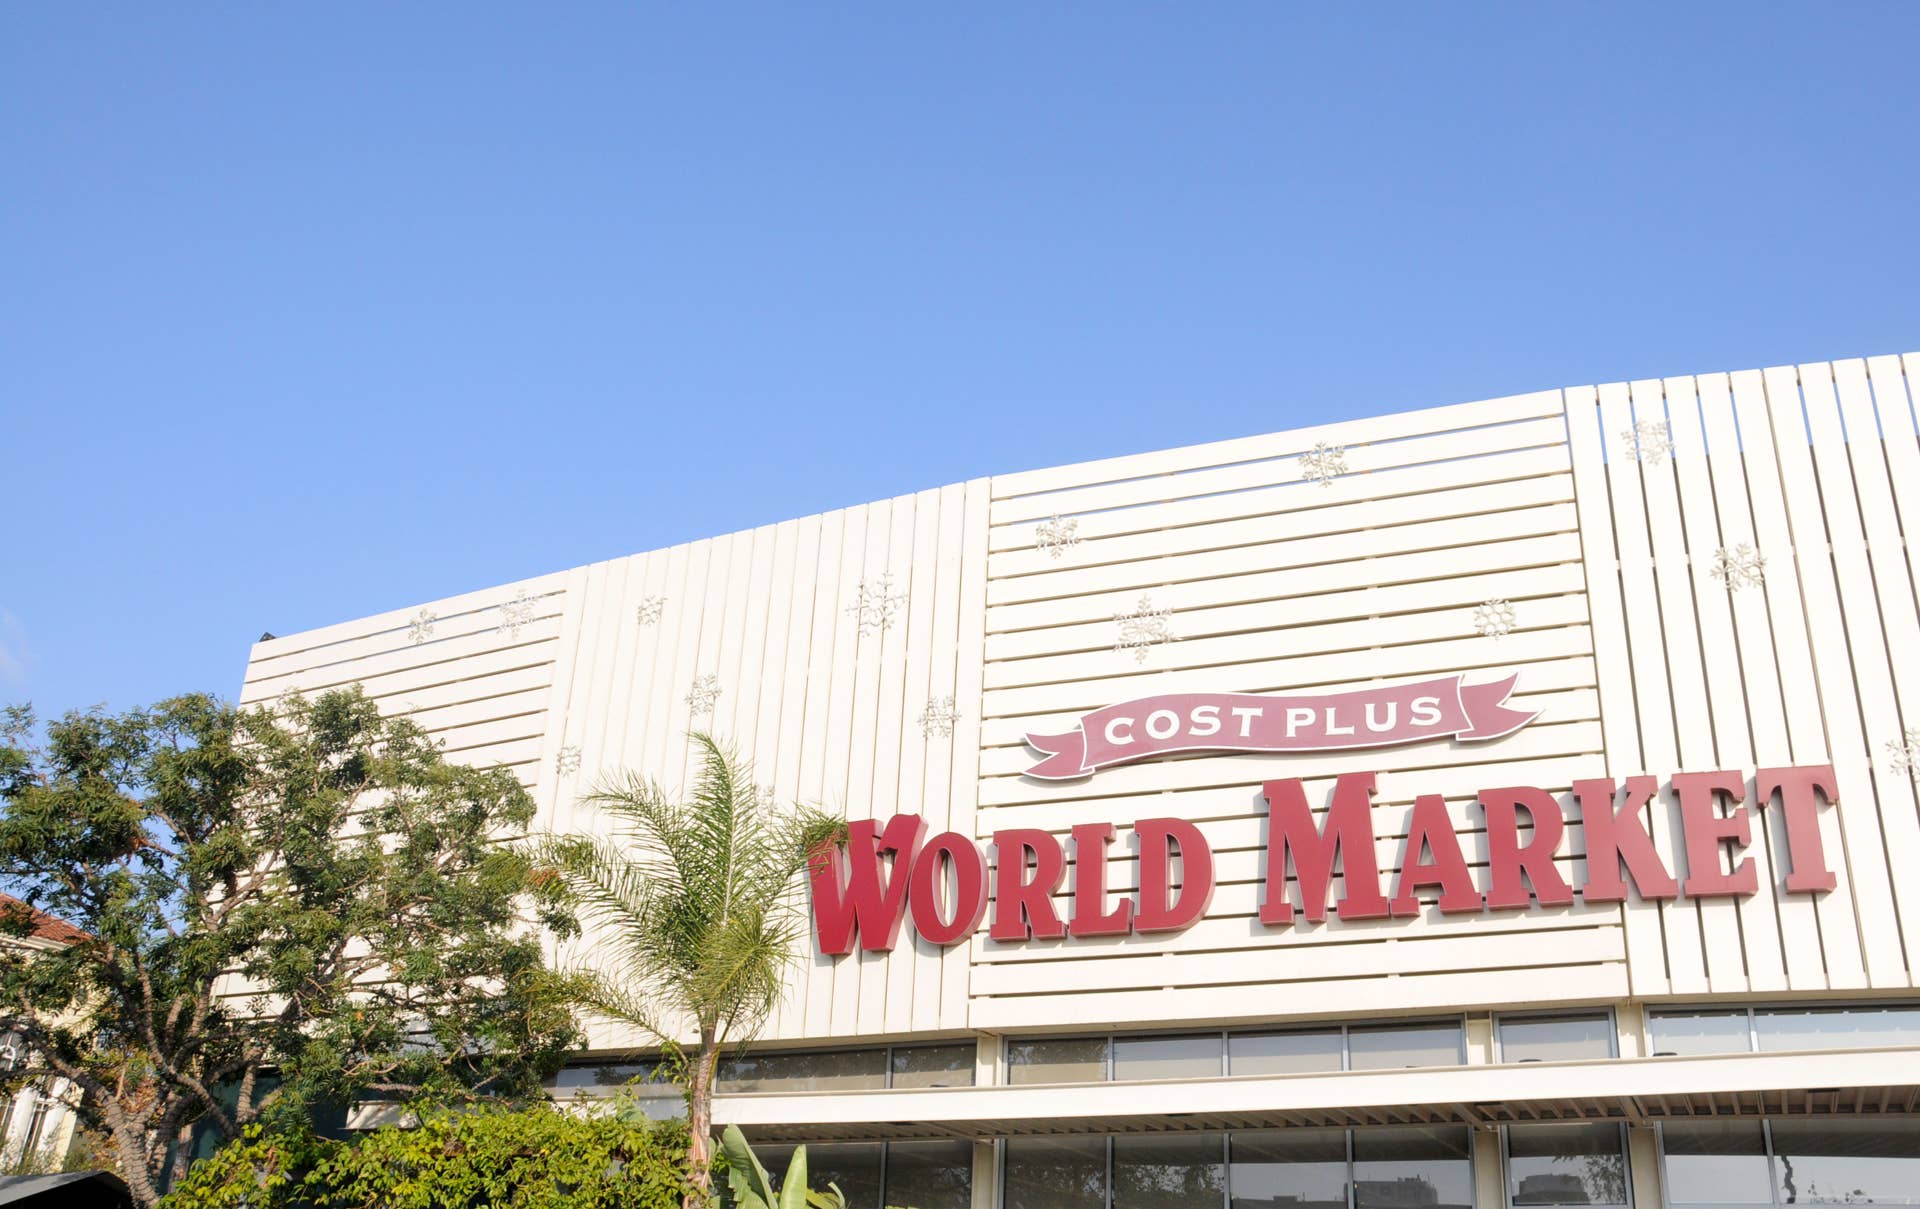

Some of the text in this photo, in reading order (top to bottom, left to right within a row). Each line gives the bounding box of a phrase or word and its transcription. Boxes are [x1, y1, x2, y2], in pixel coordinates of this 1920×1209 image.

[1104, 696, 1443, 745] COST PLUS
[809, 765, 1839, 956] WORLD MARKET
